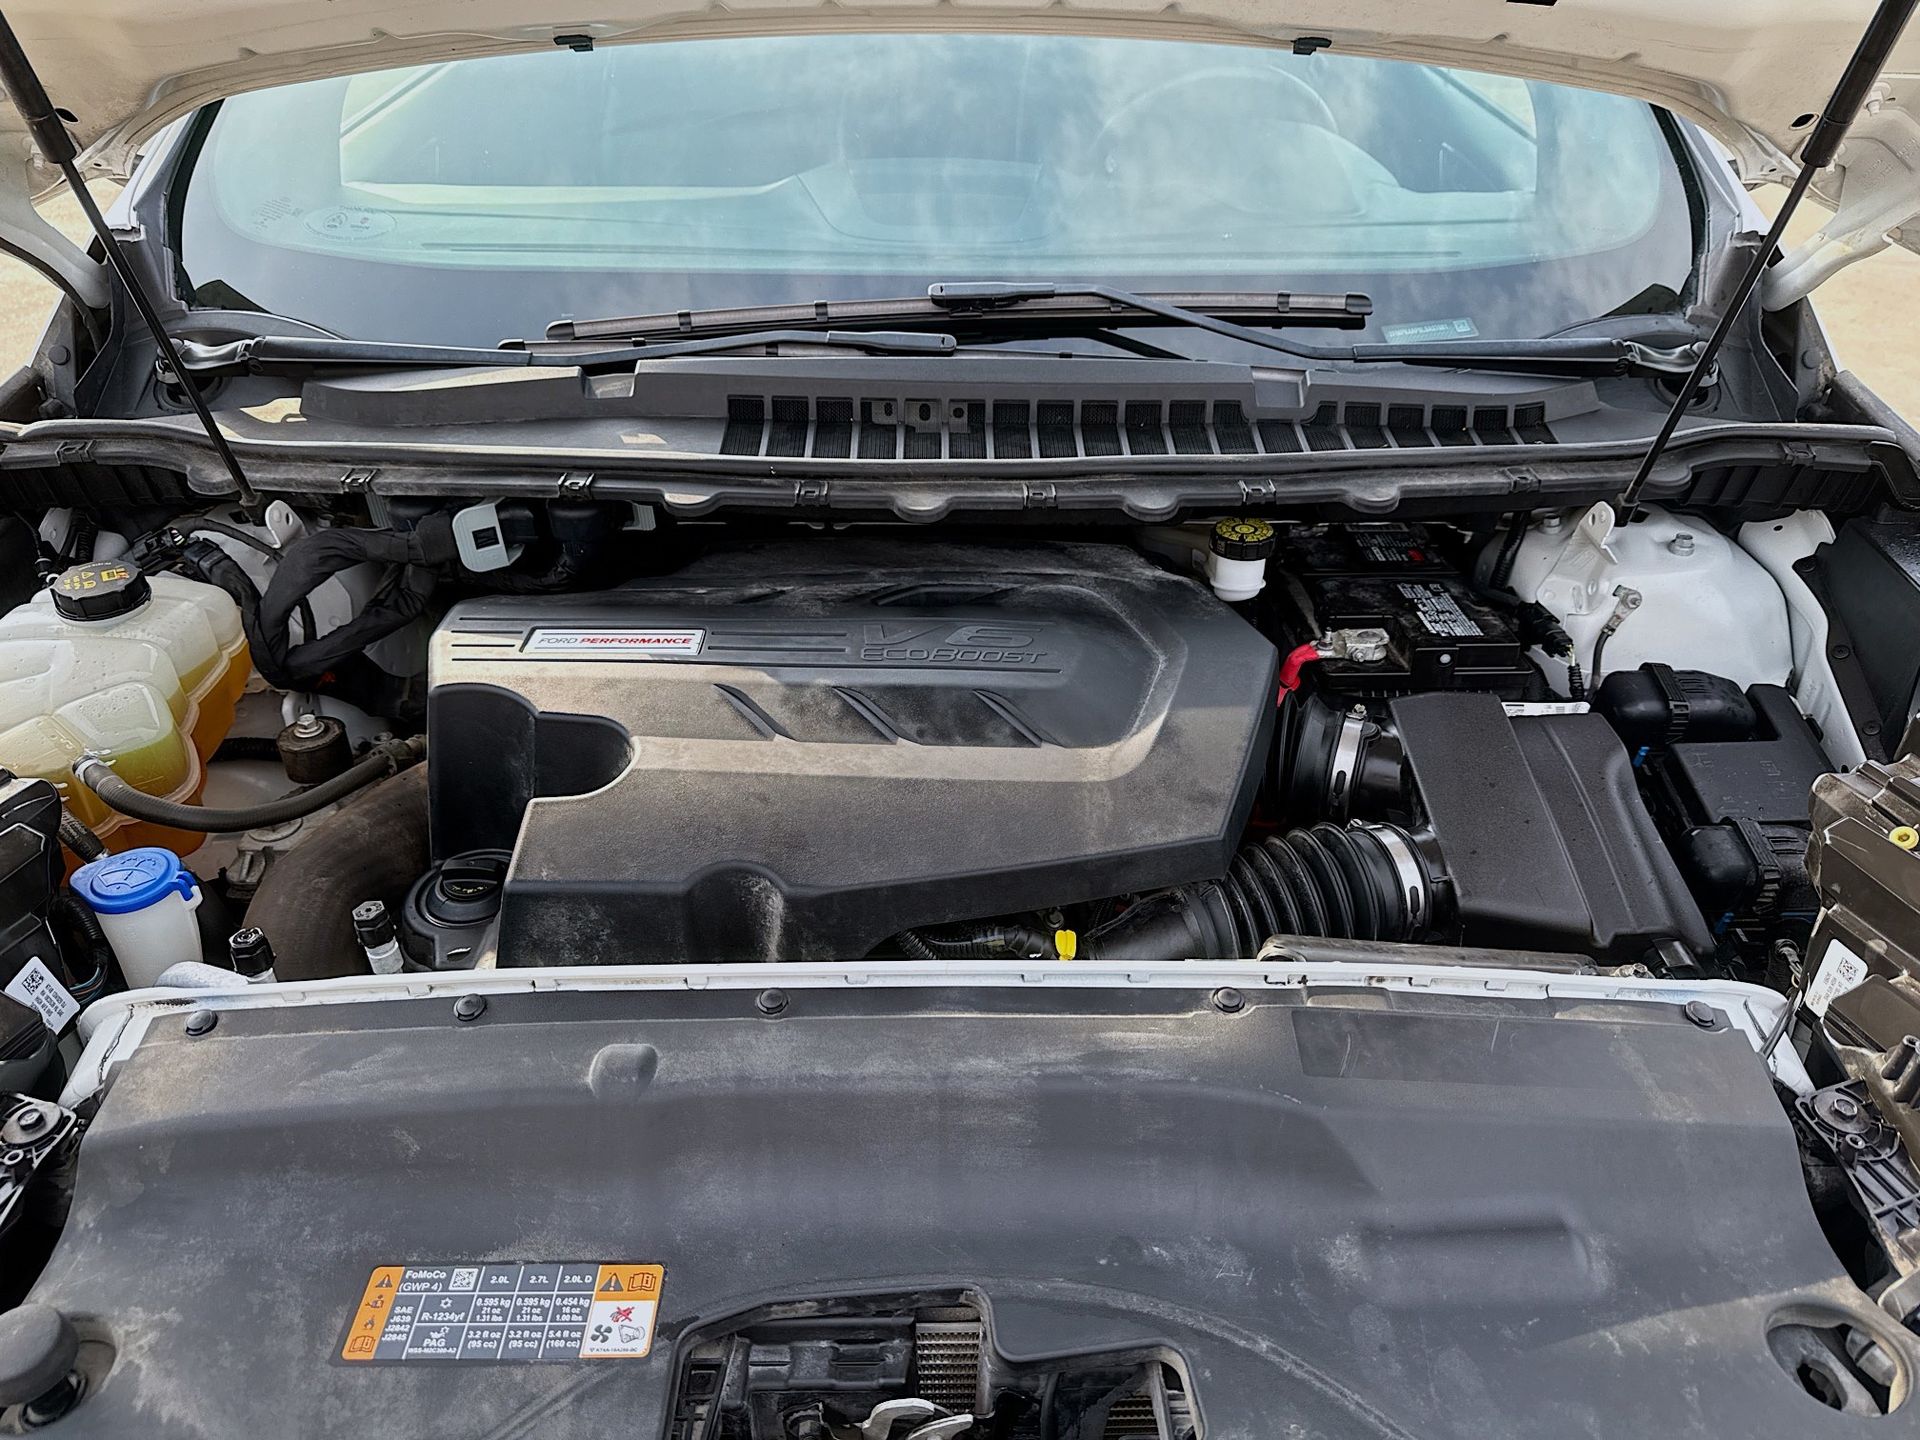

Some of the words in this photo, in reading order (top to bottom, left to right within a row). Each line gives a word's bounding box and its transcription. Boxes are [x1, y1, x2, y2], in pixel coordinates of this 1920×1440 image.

[579, 637, 693, 645] PERFORMANCE
[405, 1270, 447, 1279] FoMoCo
[490, 1275, 509, 1284] 2.0L
[529, 1275, 549, 1284] 2.7L
[563, 1275, 583, 1284] 2.0L
[584, 1275, 592, 1283] D
[399, 1282, 430, 1292] (GWP
[430, 1282, 442, 1292] 4)
[476, 1297, 499, 1306] 0.595
[500, 1297, 511, 1308] kg
[516, 1297, 539, 1306] 0.595
[540, 1297, 551, 1308] kg
[555, 1297, 578, 1306] 0.454
[579, 1297, 590, 1308] kg
[394, 1306, 414, 1314] SAE
[389, 1315, 411, 1323] J639
[421, 1312, 465, 1322] R-1234yf
[467, 1330, 481, 1338] 3.2
[508, 1330, 522, 1338] 3.2
[547, 1330, 561, 1338] 5.4
[423, 1339, 446, 1347] PAG
[483, 1340, 497, 1349] cc)
[523, 1340, 538, 1349] cc)
[566, 1340, 580, 1349] cc)
